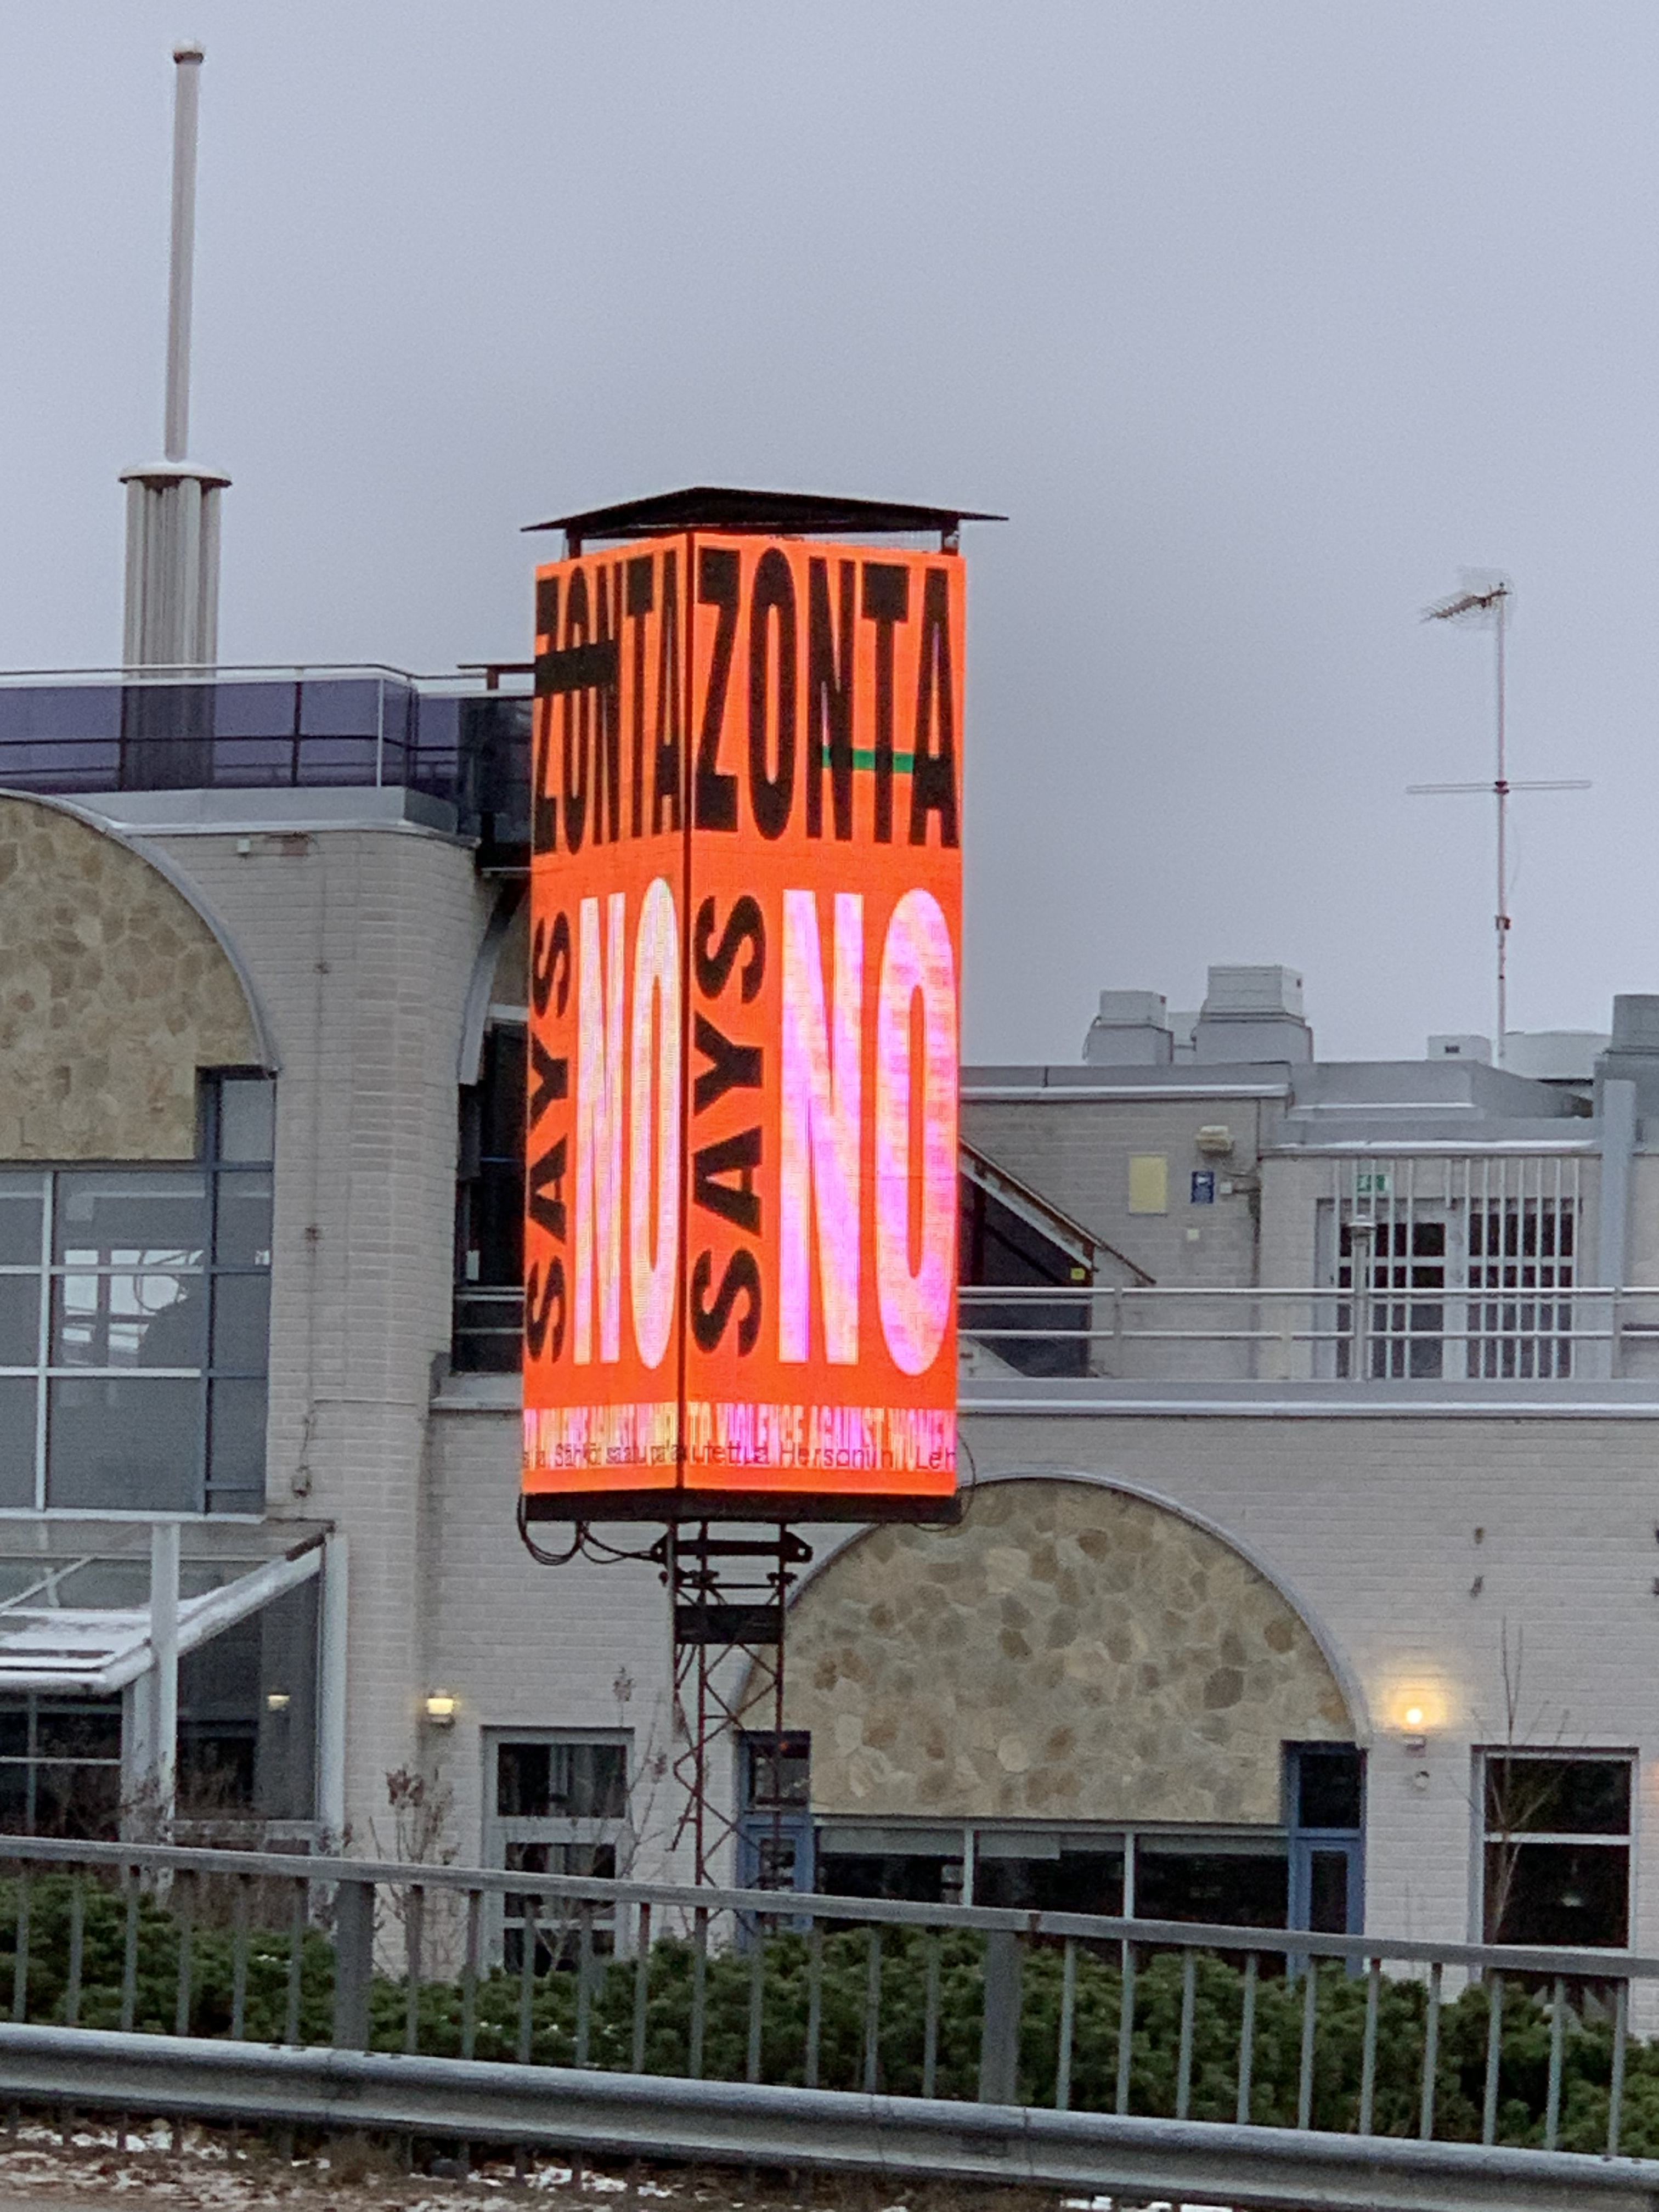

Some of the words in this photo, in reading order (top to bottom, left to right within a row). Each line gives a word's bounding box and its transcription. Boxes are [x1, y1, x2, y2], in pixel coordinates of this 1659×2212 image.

[534, 550, 683, 856] ZONTA
[695, 545, 960, 849] ZONTA
[526, 911, 571, 1364] SAYS
[574, 877, 682, 1369] NO
[691, 895, 766, 1358] SAYS
[779, 888, 958, 1376] NO
